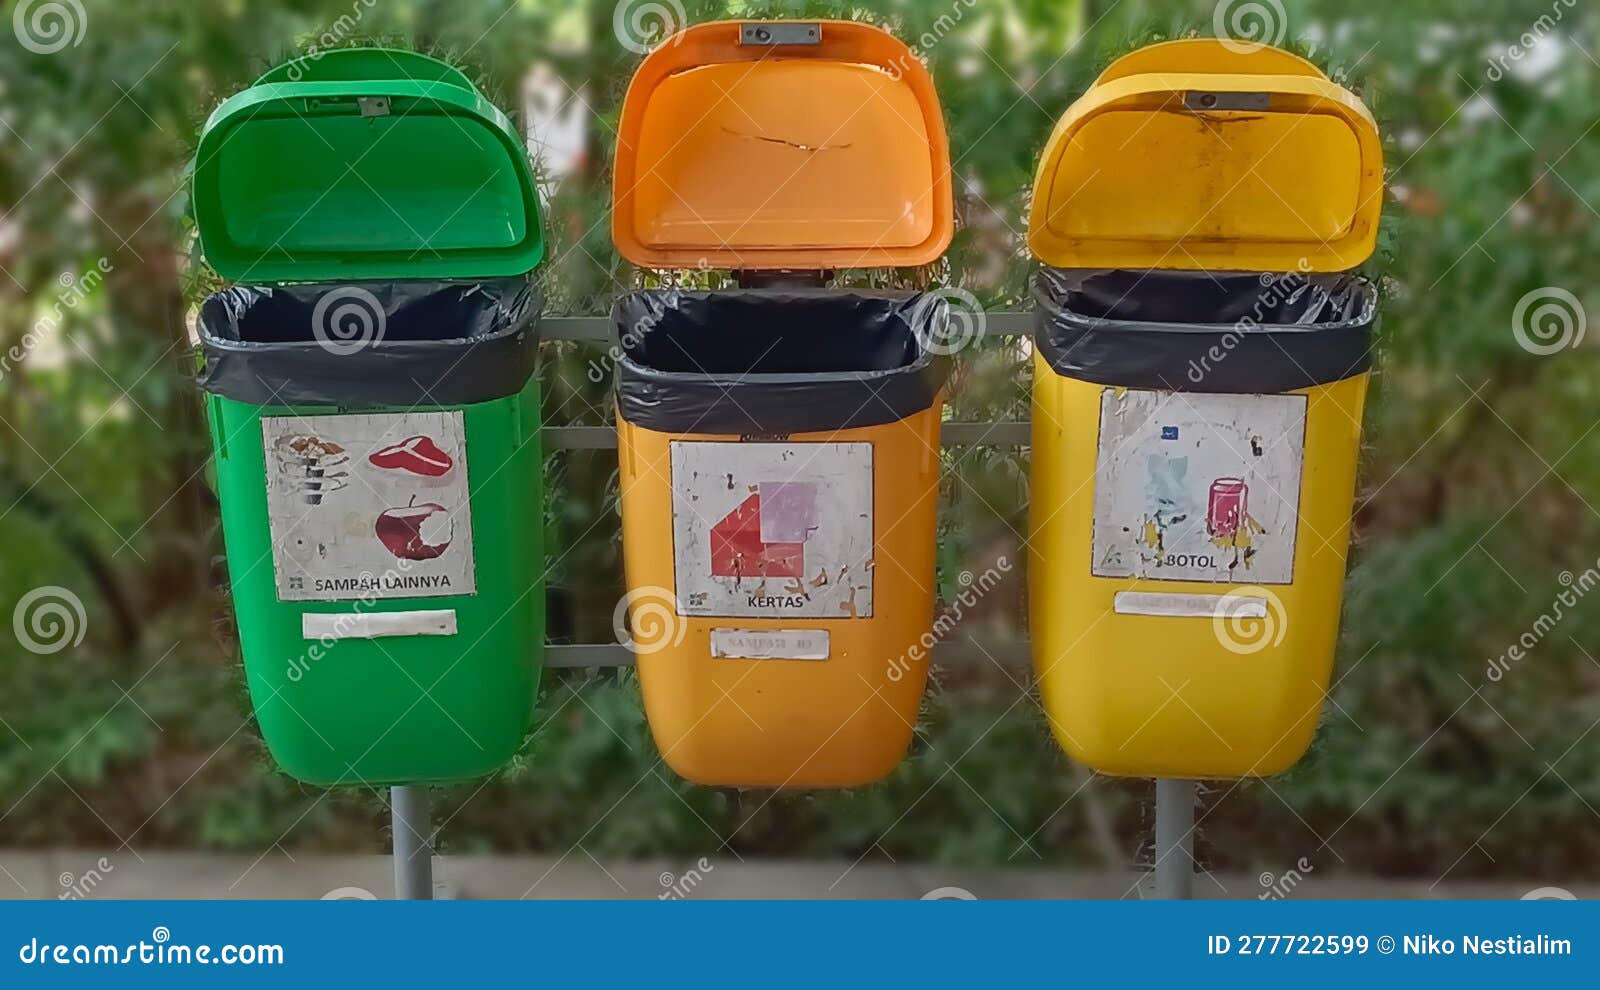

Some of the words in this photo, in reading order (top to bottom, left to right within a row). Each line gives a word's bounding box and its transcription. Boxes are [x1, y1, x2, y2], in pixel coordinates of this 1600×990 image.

[1165, 555, 1217, 568] BOTOL
[315, 578, 381, 591] SAMPAH
[385, 575, 451, 588] LAINNYA
[748, 597, 804, 608] KERTAS
